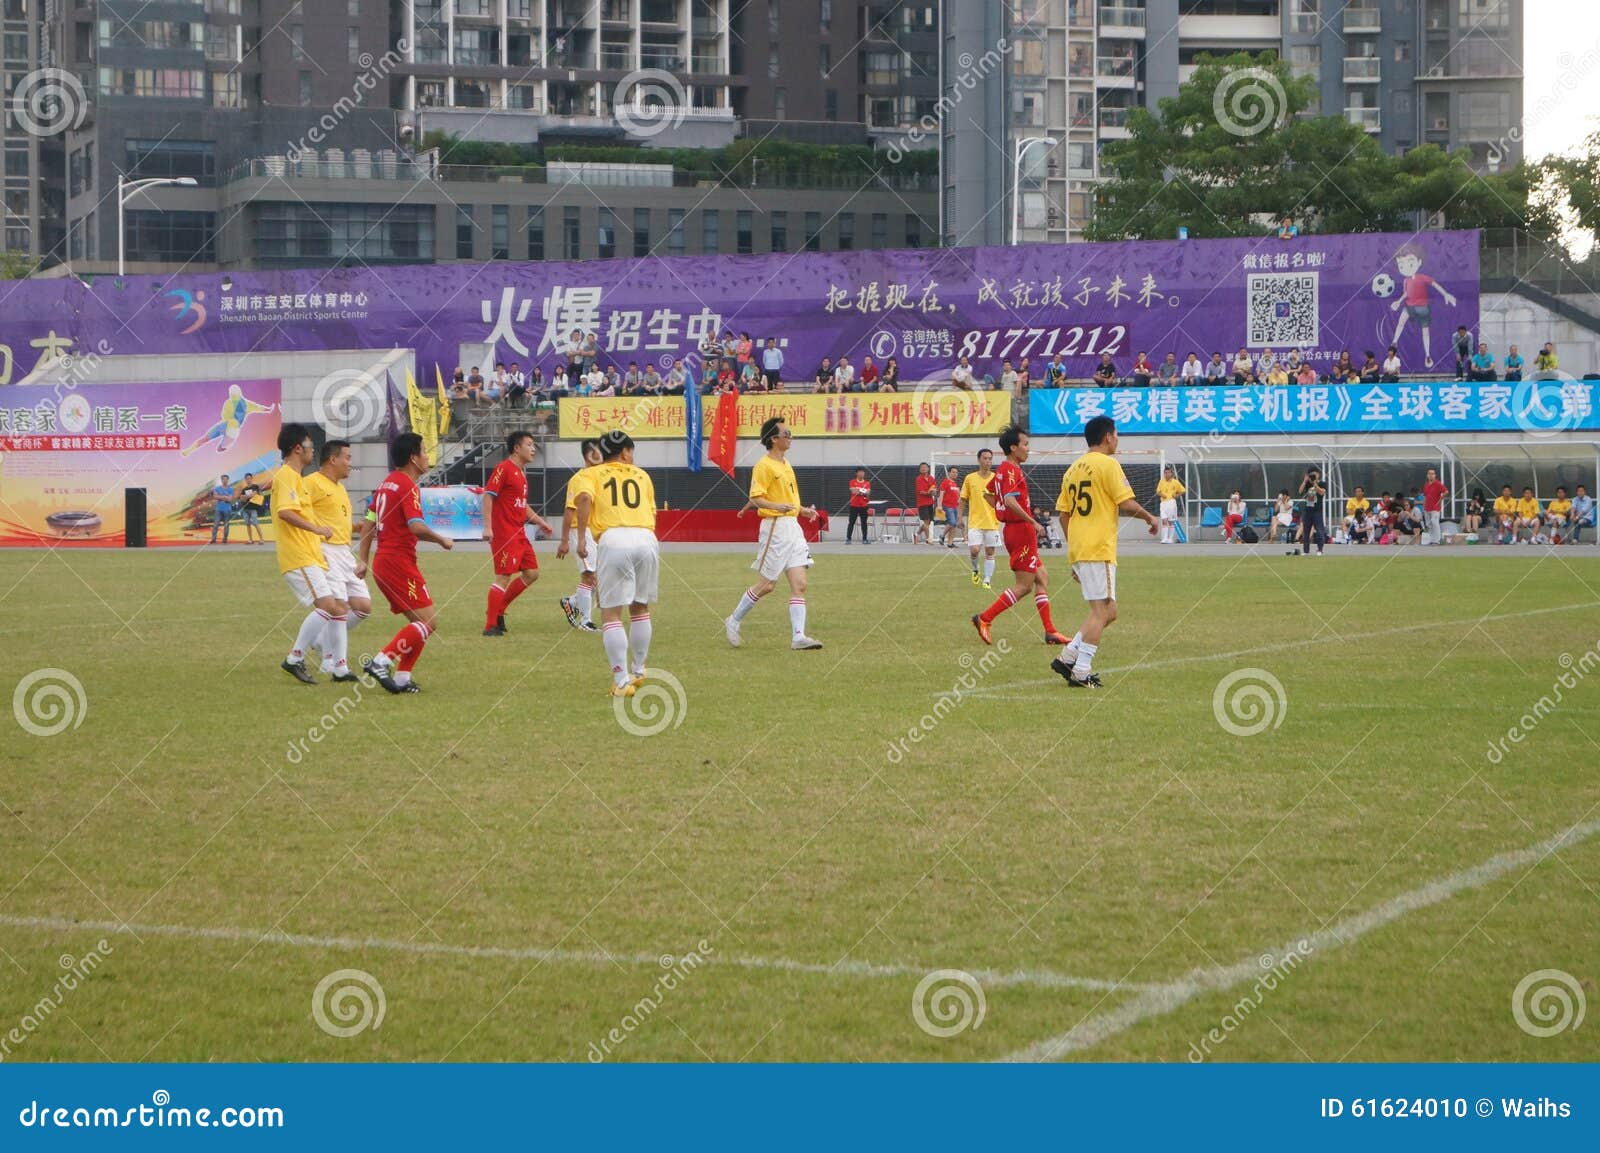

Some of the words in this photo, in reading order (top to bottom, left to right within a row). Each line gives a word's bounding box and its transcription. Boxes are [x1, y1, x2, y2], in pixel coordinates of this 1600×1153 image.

[220, 291, 369, 311] 深圳市宝安区体育中心
[219, 312, 257, 322] Shenzhen
[258, 311, 283, 321] Baoan
[284, 310, 313, 321] District
[313, 310, 340, 320] Sports
[341, 309, 369, 319] Center
[902, 344, 954, 359] 0755
[957, 325, 1127, 359] 81771212
[93, 405, 188, 432] 情系一家
[602, 476, 641, 509] 10
